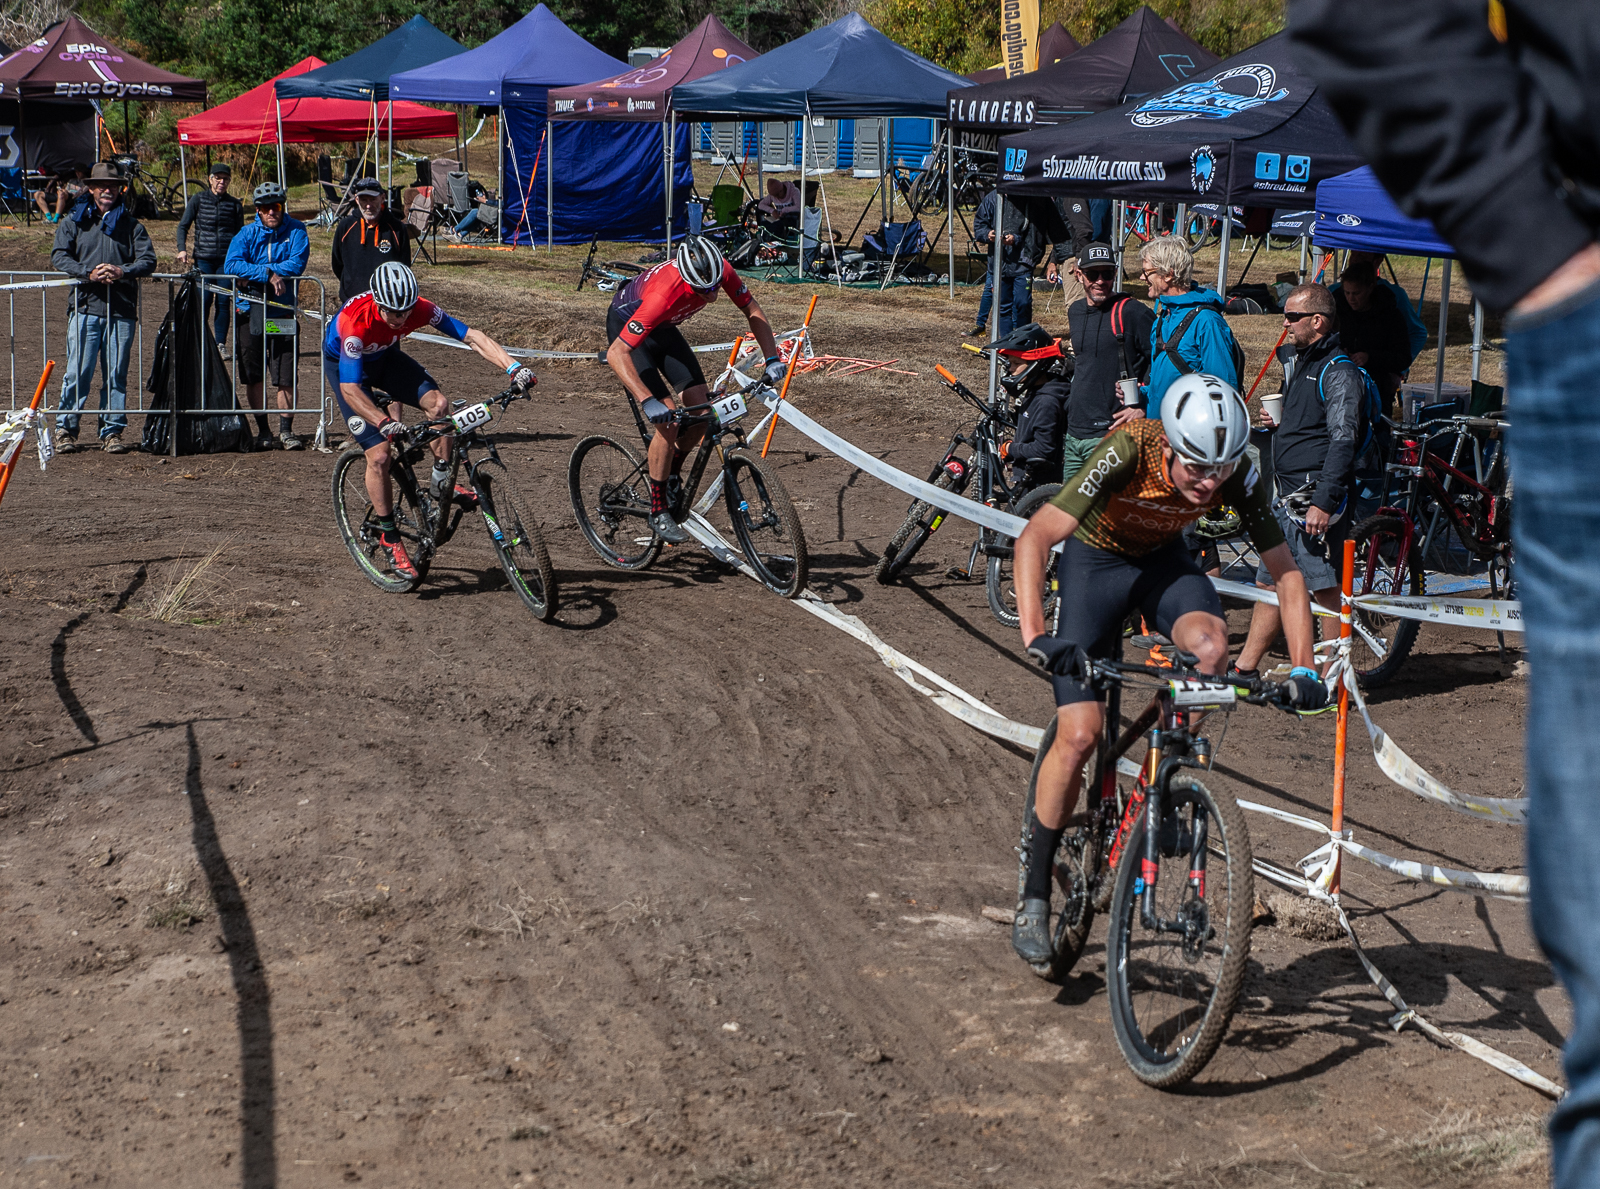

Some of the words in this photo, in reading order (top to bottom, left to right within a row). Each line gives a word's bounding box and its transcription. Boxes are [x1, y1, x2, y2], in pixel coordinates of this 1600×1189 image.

[66, 43, 108, 54] Epic
[58, 52, 124, 63] Cycles
[54, 81, 100, 98] Epic
[101, 80, 173, 97] Cycles
[554, 99, 575, 112] THULE
[635, 100, 655, 110] MOTION
[949, 99, 1034, 123] FLANDERS
[1042, 155, 1166, 181] shredbike.com.au
[1253, 182, 1306, 193] @shred.bike
[1090, 249, 1108, 257] FOX
[629, 321, 643, 334] GU
[721, 399, 740, 415] 16
[458, 407, 486, 429] 105
[1078, 446, 1123, 497] pedla
[1506, 609, 1523, 620] AUSCY
